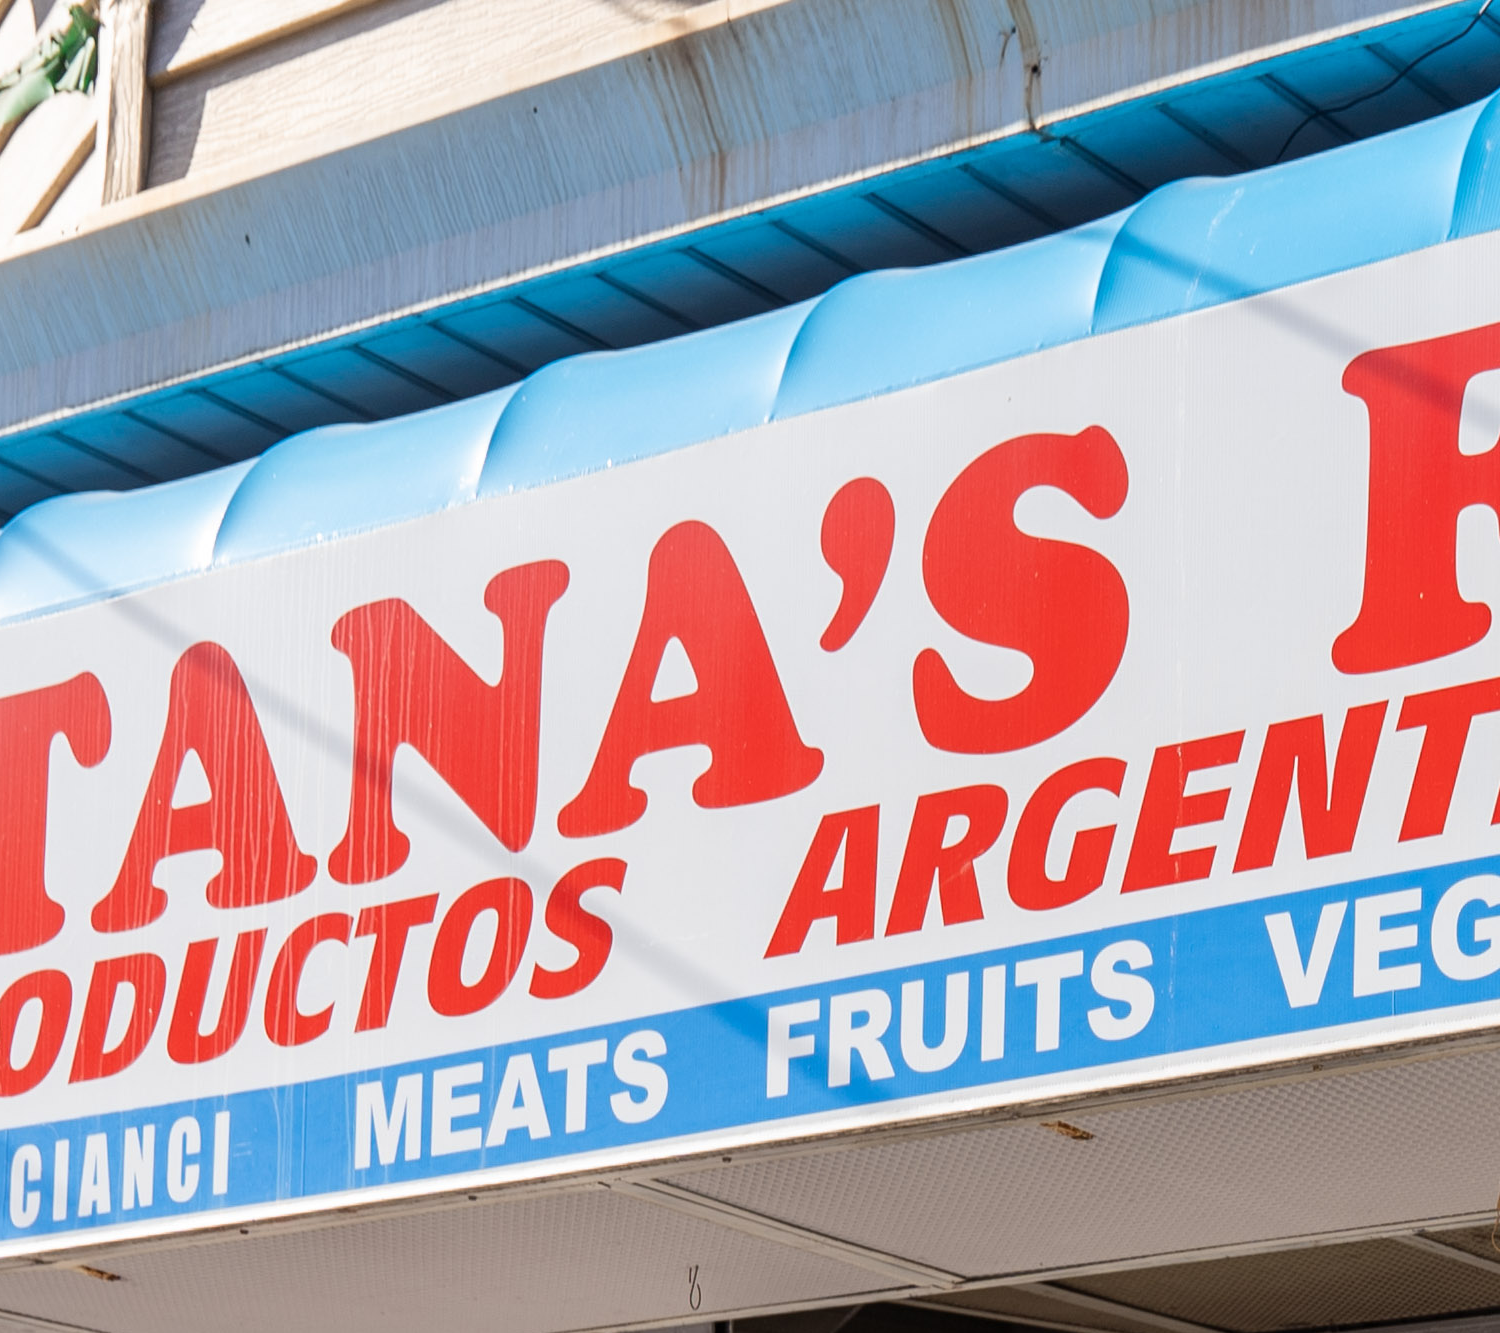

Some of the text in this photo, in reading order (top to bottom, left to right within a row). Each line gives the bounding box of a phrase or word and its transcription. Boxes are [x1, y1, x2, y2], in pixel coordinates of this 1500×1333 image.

[9, 1111, 233, 1232] CIANCI
[353, 1029, 670, 1170] MEATS
[762, 939, 1157, 1100] FRUITS
